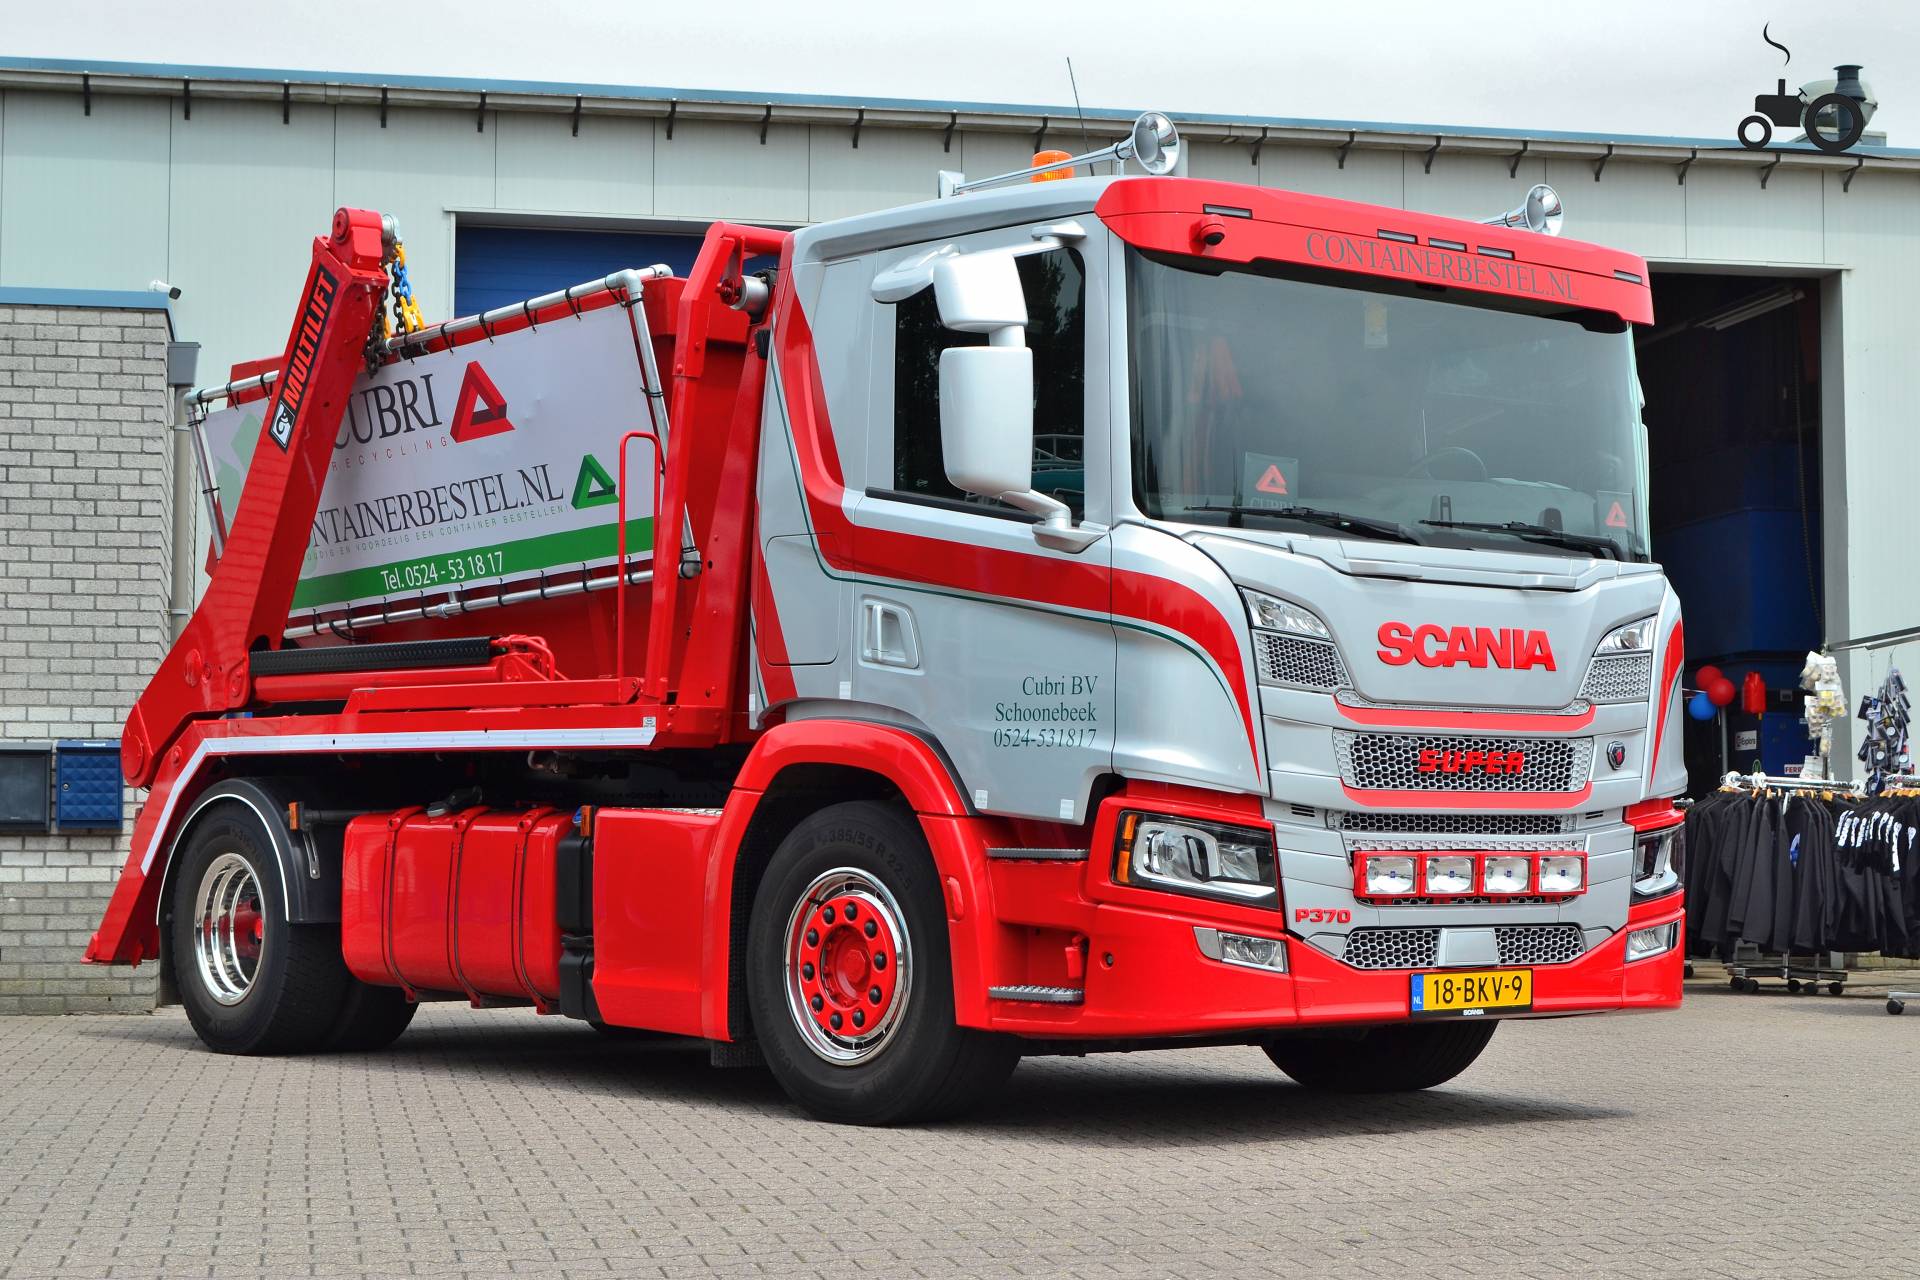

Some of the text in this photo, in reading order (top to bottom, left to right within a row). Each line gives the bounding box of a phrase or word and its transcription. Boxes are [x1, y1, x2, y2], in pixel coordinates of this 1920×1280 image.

[1306, 232, 1581, 301] CONTAINERBESTEL.NL
[283, 272, 334, 410] MULTILIFT
[331, 436, 447, 471] RECYCLING
[308, 464, 564, 548] NTAINERBESTEL.NL
[416, 529, 434, 542] EEN
[440, 518, 497, 537] CONTAINER
[381, 567, 405, 591] Tel.
[405, 562, 438, 587] 0524
[448, 558, 466, 580] 53
[468, 554, 486, 576] 18
[488, 551, 503, 574] 17
[1377, 620, 1557, 672] SCANIA
[1022, 675, 1099, 696] Cubri BV
[995, 701, 1098, 722] Schoonebeek
[993, 728, 1098, 748] 0524-531817
[1418, 750, 1525, 774] SUPER
[1295, 907, 1352, 924] P370
[1413, 996, 1423, 1005] NL
[1433, 975, 1523, 1005] 18-BKV-9
